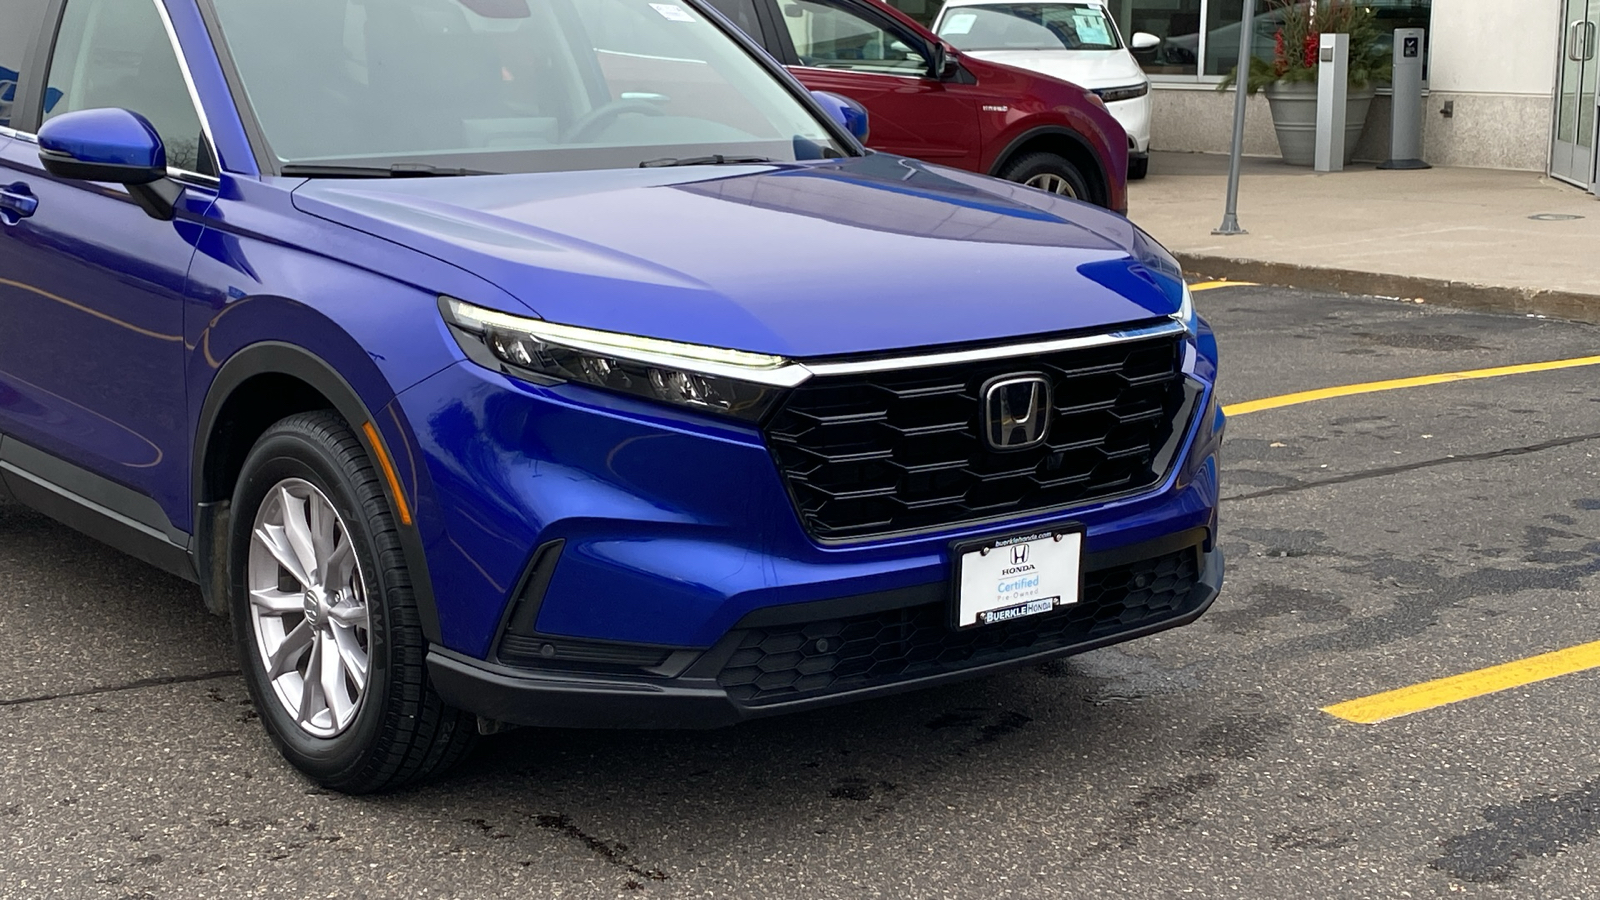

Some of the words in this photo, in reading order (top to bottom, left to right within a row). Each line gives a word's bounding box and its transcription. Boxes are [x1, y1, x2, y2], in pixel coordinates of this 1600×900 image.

[995, 531, 1052, 547] buerklehonda.com
[1002, 564, 1035, 575] HONDA
[997, 574, 1039, 593] Certified
[996, 588, 1039, 602] Pre-Owned
